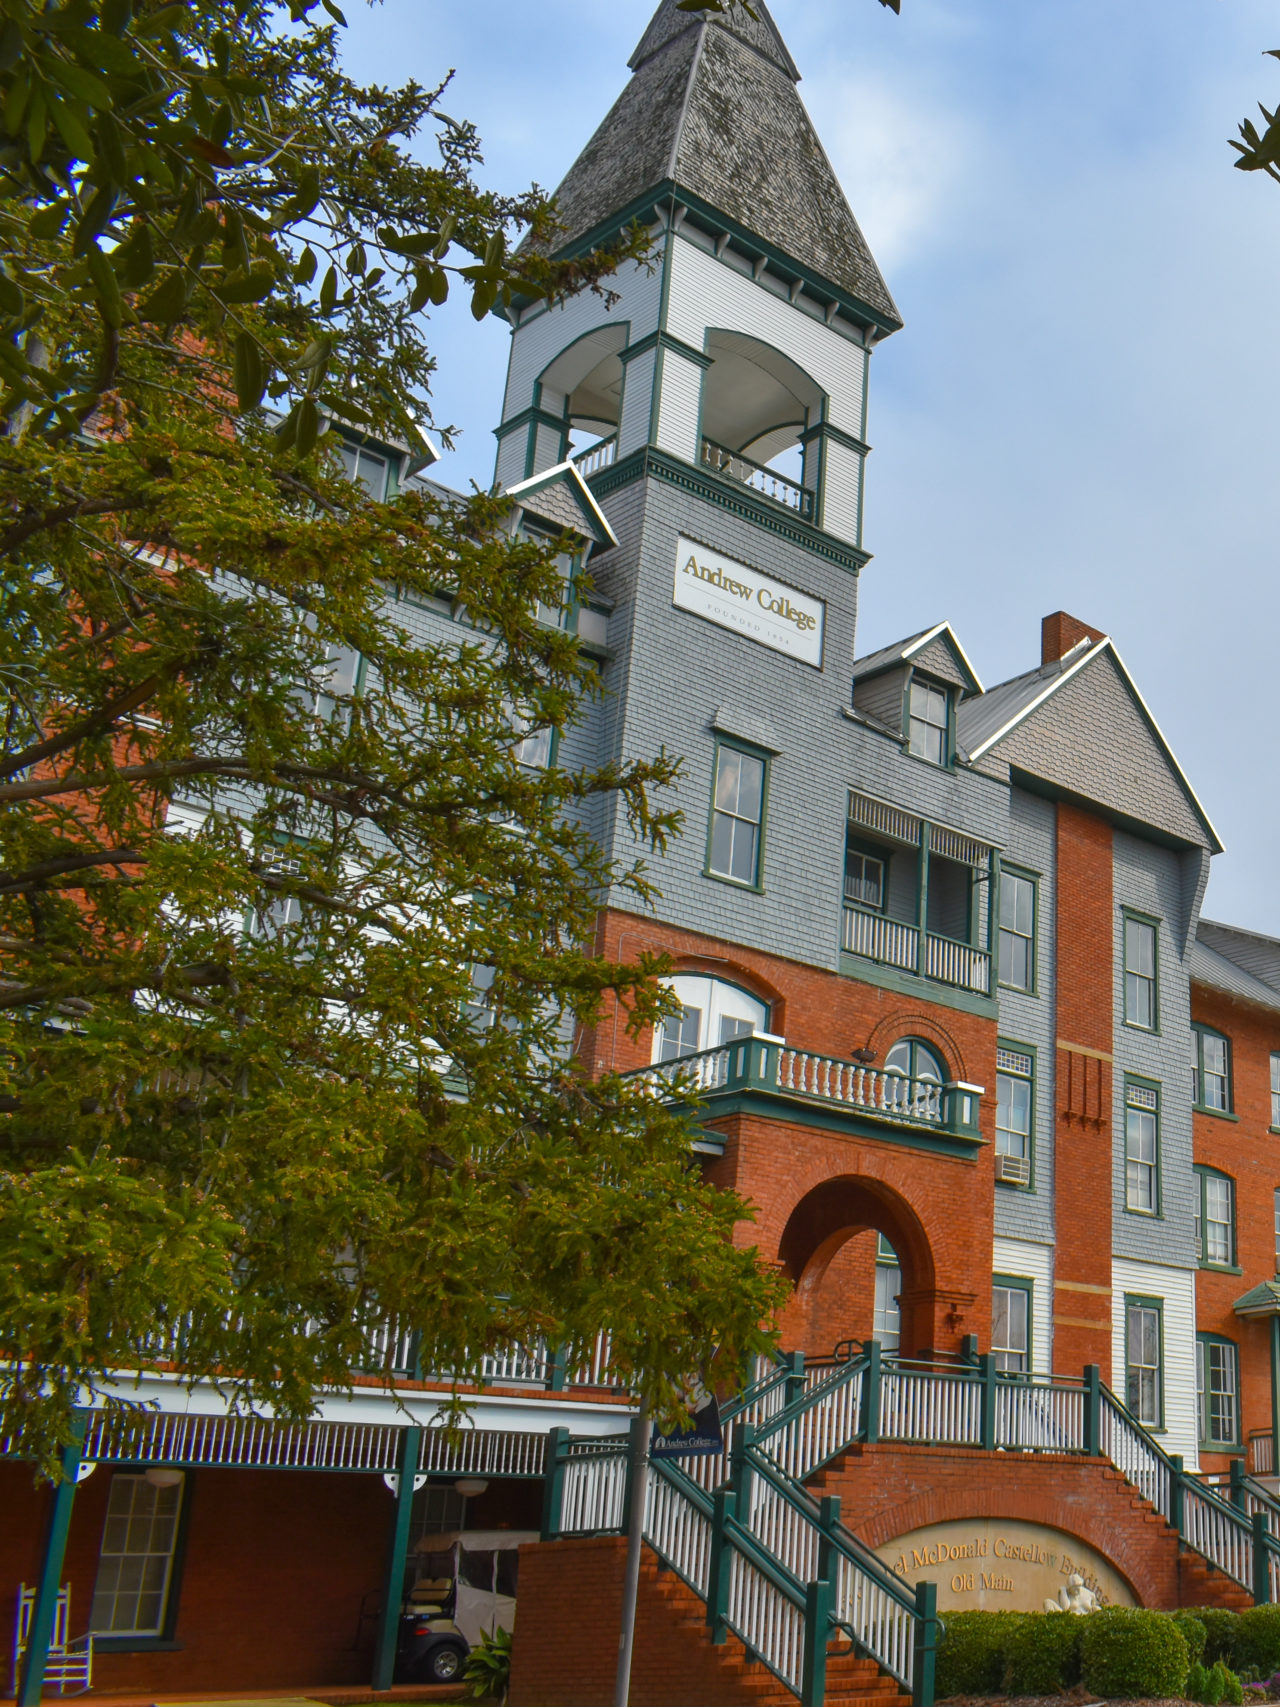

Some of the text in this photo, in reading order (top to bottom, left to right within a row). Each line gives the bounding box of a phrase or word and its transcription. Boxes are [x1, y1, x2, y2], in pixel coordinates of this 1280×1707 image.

[683, 555, 816, 631] Andrew College
[707, 603, 790, 646] FOUNDED 1854
[912, 1539, 989, 1570] McDonald
[993, 1538, 1057, 1568] Castellow
[951, 1572, 1015, 1594] Old Main
